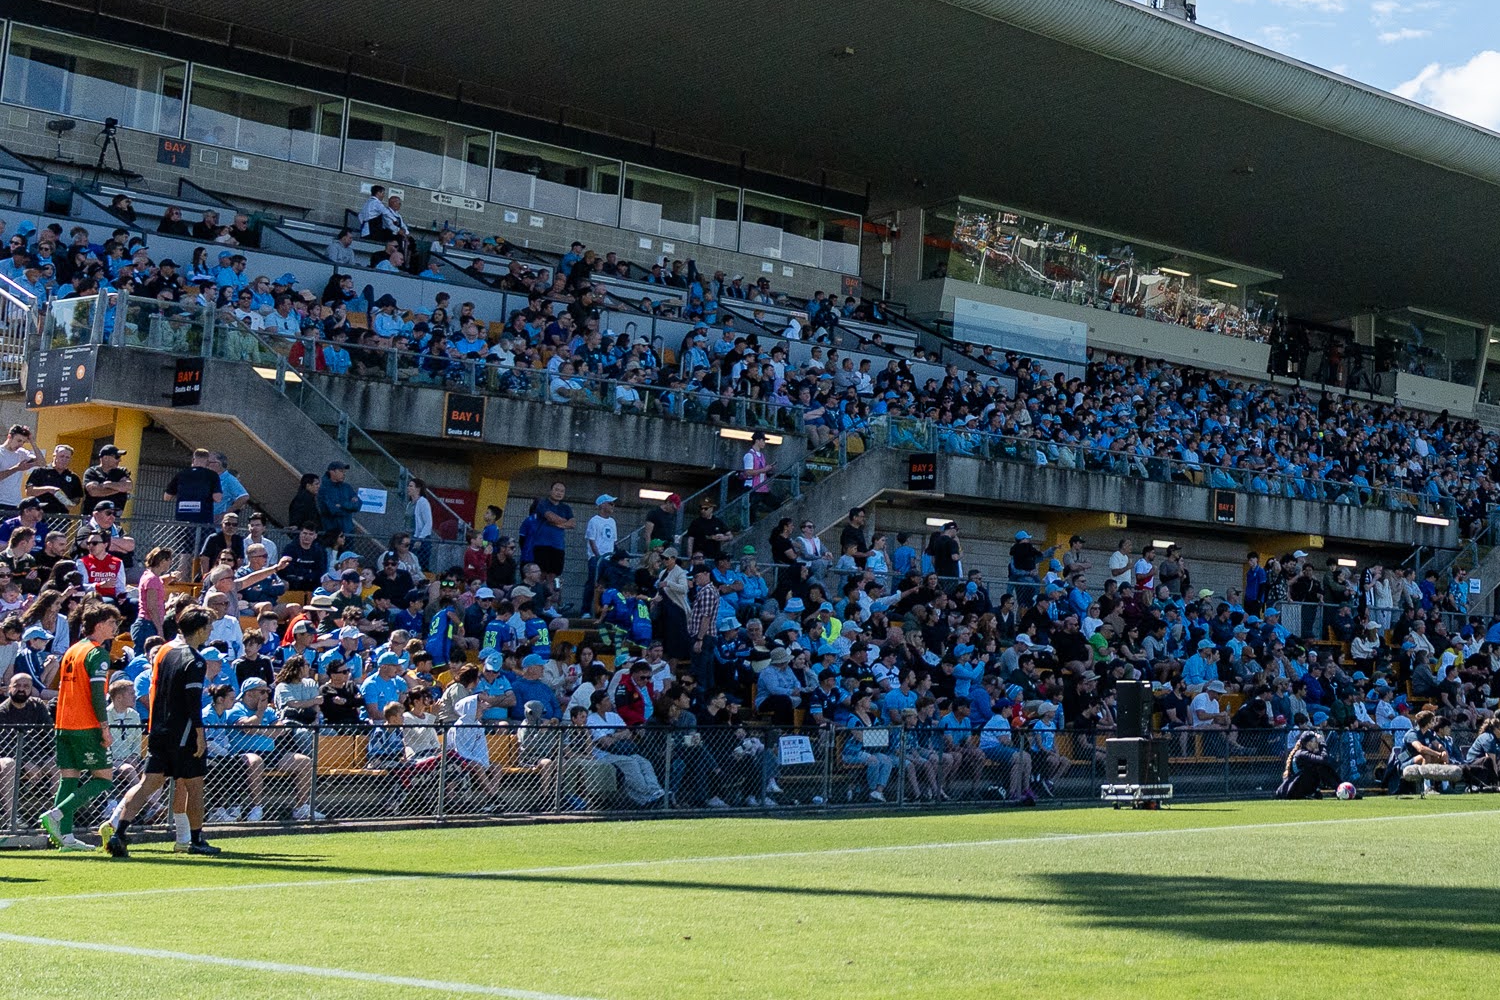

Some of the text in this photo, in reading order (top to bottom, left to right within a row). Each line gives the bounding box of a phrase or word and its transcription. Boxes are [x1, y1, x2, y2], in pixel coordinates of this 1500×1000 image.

[164, 141, 187, 153] BAY
[177, 370, 200, 383] BAY 1
[451, 410, 480, 423] BAY 1
[912, 463, 933, 473] BAY 2
